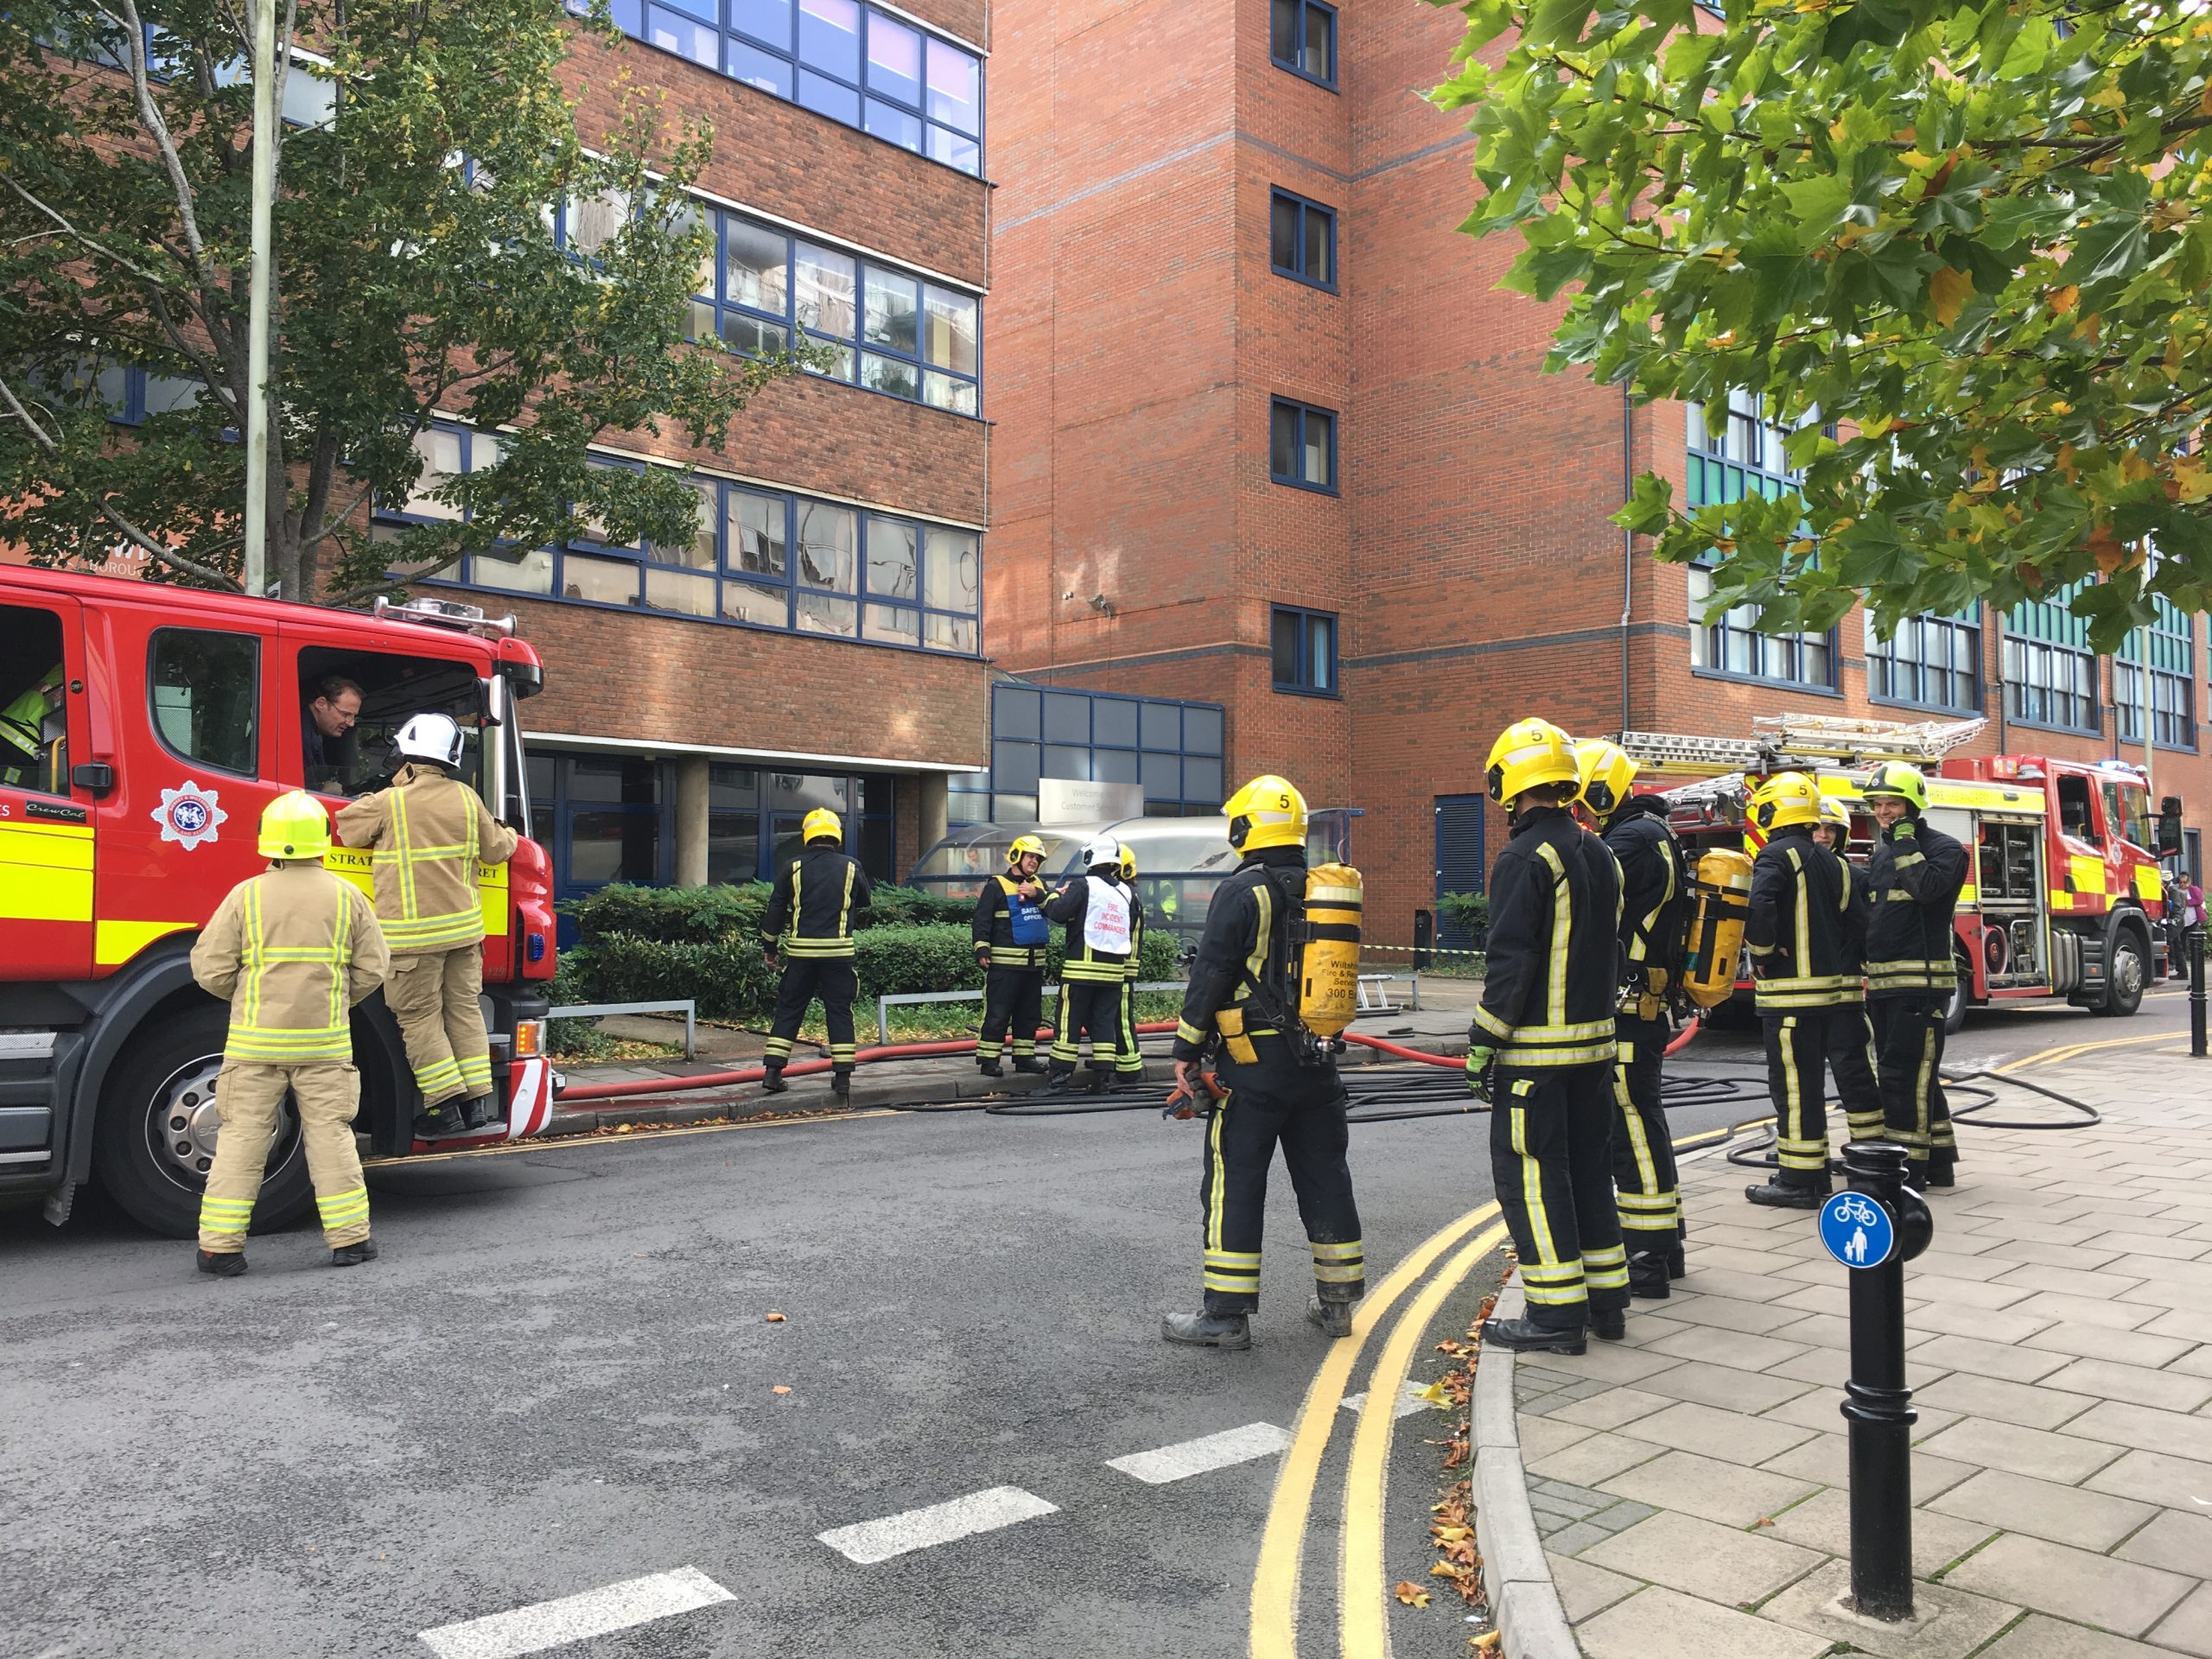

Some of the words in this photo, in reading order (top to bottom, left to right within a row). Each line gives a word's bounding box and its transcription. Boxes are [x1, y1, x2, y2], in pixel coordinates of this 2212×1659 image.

[89, 562, 142, 577] BOROU
[1531, 728, 1543, 742] 5
[1799, 784, 1808, 796] 5
[1280, 793, 1290, 810] 5
[329, 853, 372, 866] STRAT
[1108, 902, 1119, 912] FIRE
[1102, 912, 1124, 924] INCIDENT
[1093, 921, 1127, 935] COMMANDER
[1322, 969, 1338, 977] Fire
[1326, 988, 1346, 1000] 300
